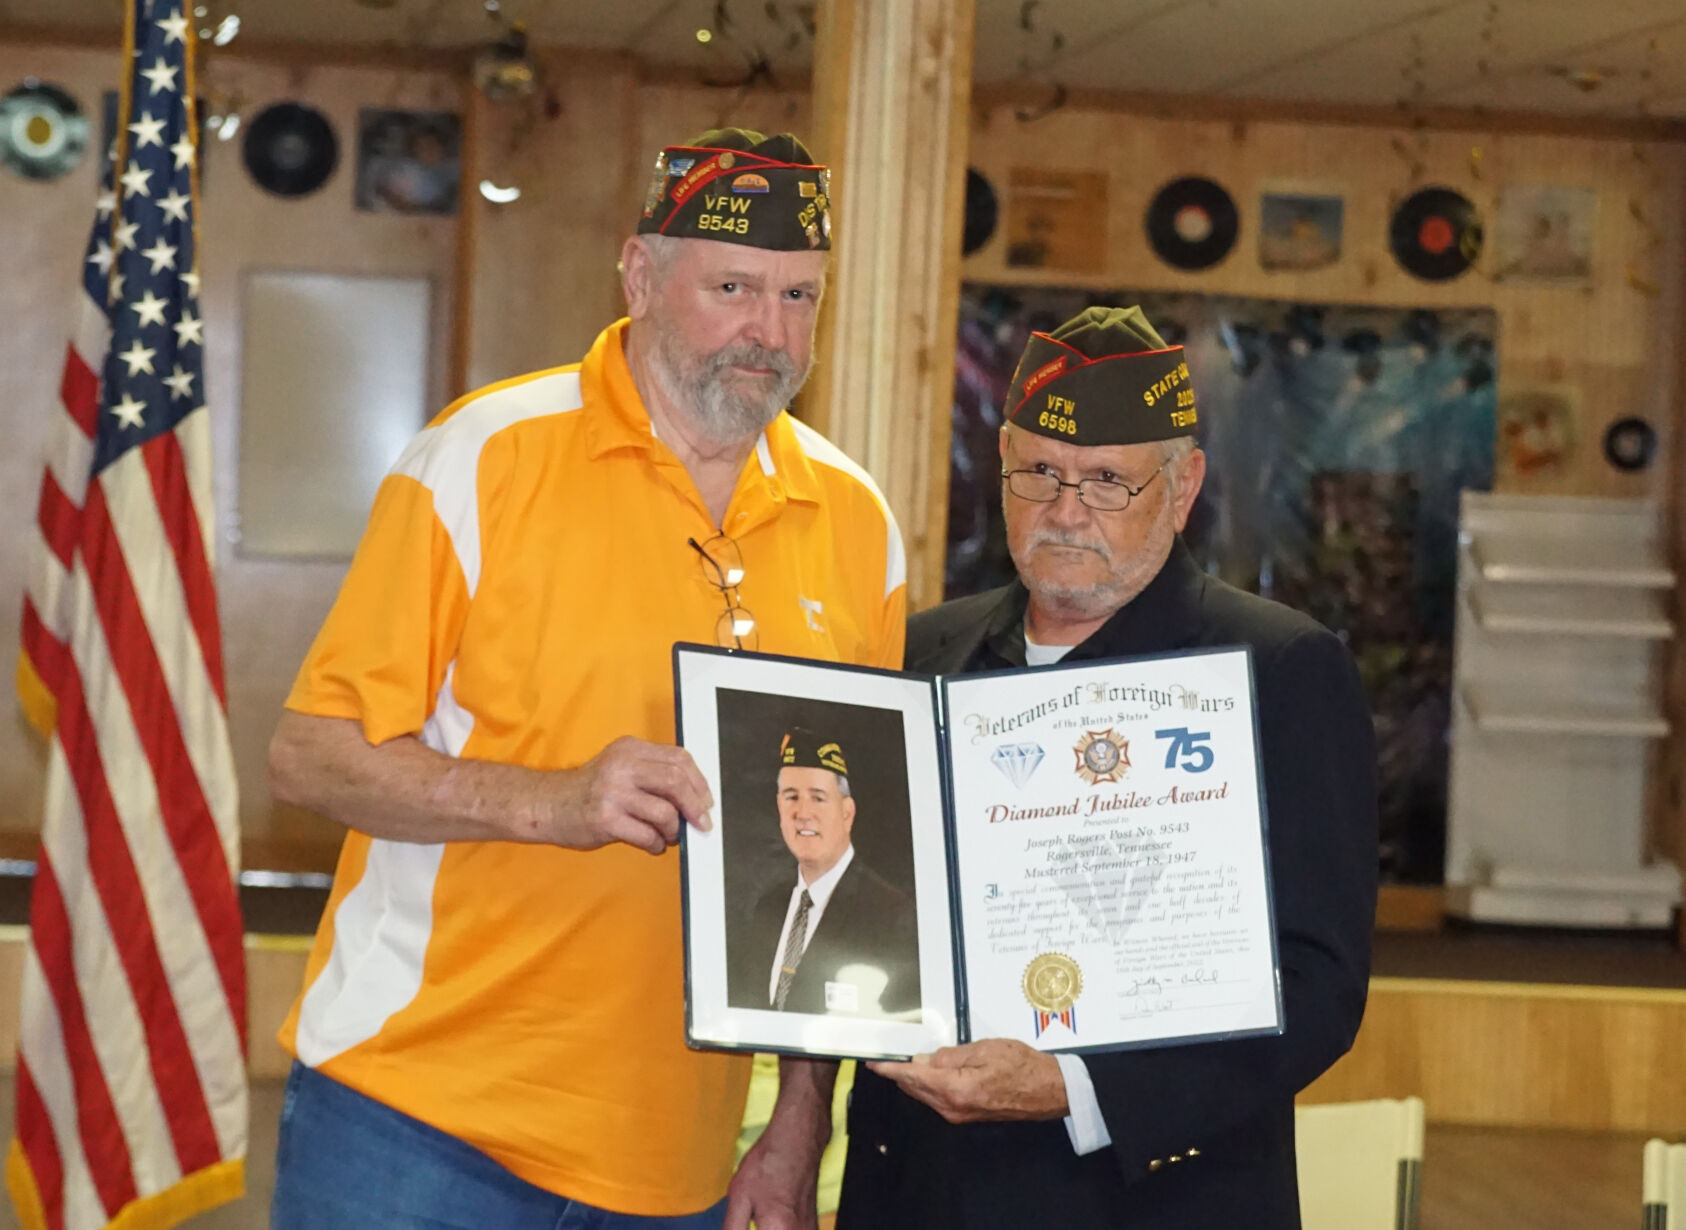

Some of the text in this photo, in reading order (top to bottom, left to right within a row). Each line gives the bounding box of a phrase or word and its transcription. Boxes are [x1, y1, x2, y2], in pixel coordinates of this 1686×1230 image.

[704, 194, 751, 214] VFW
[698, 213, 749, 235] 9543
[1143, 369, 1180, 407] STATE
[1047, 394, 1076, 416] VFW
[1039, 411, 1078, 435] 6598
[964, 682, 1235, 745] Veterans of Foreign Wars
[1064, 717, 1077, 728] the
[1080, 714, 1114, 727] United
[1116, 711, 1149, 725] States
[1154, 727, 1214, 773] 75
[985, 781, 1229, 823] Diamond Jubilee Award
[1024, 835, 1063, 852] Joseph
[1067, 833, 1106, 846] Rogers
[1109, 829, 1133, 840] Post
[1159, 822, 1190, 835] 9543
[1046, 840, 1173, 863] Rogersville, Tennessee
[1024, 865, 1078, 879] Mustered
[1081, 858, 1141, 874] September
[1167, 851, 1198, 864] 1947
